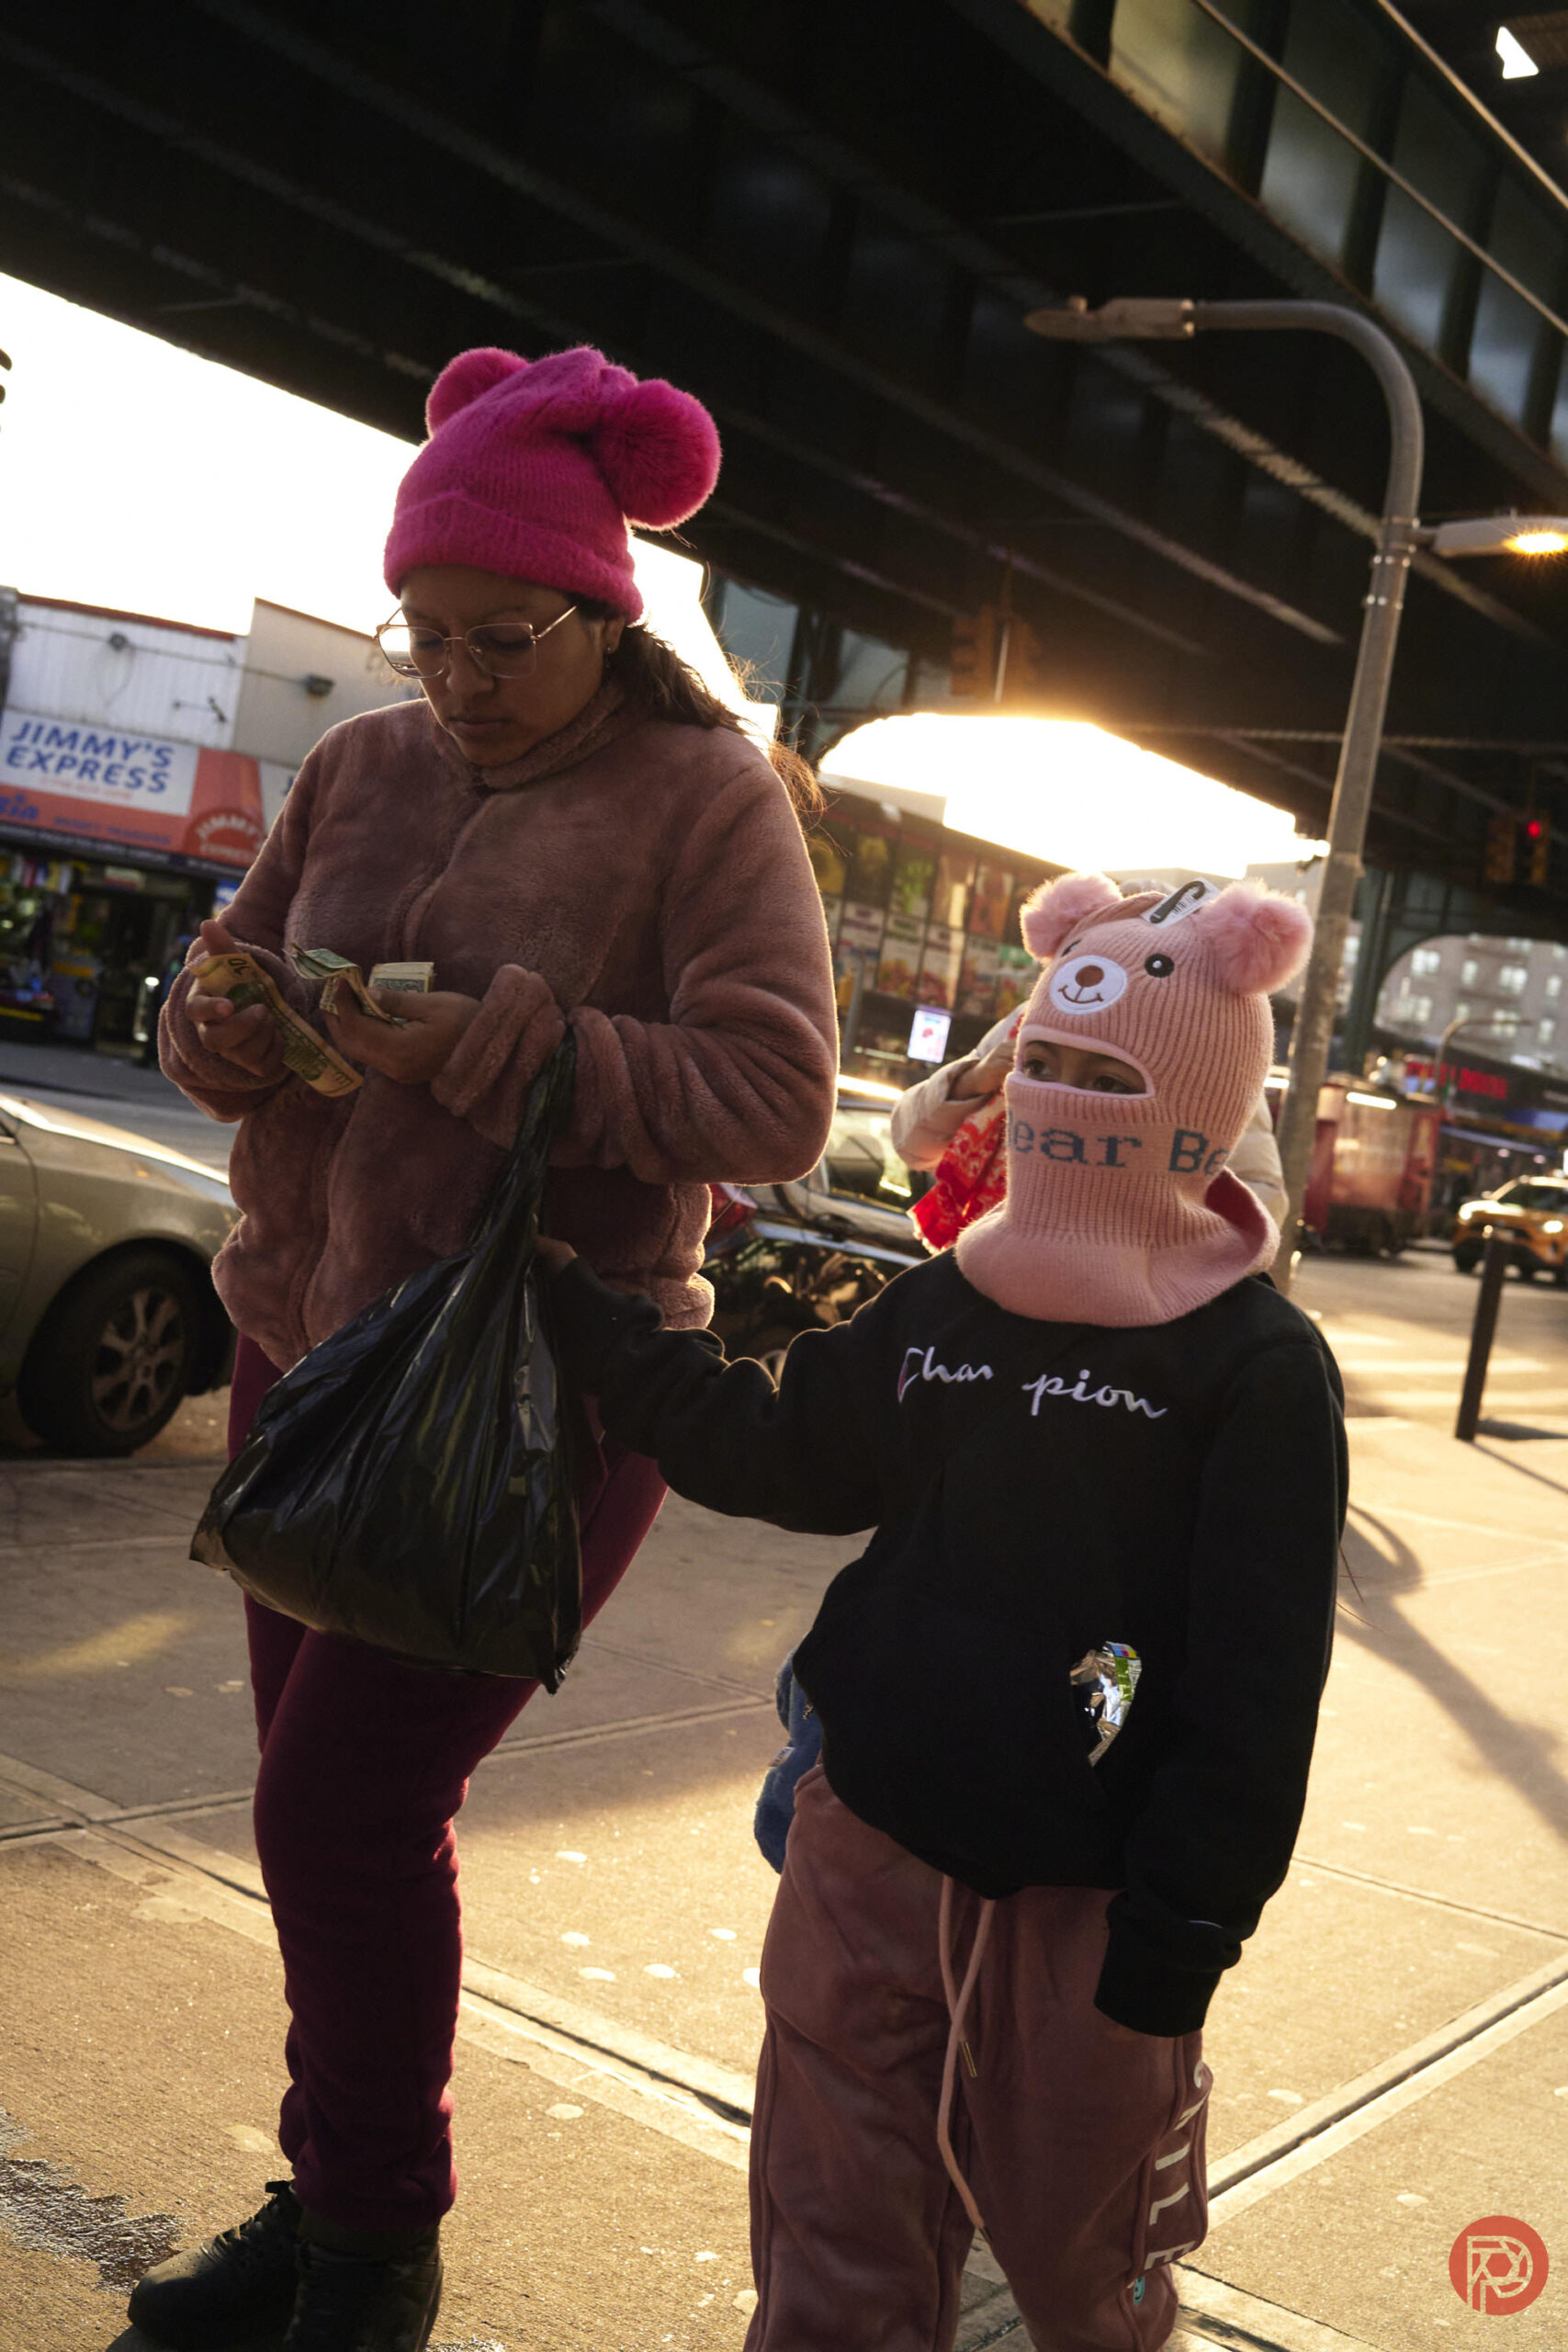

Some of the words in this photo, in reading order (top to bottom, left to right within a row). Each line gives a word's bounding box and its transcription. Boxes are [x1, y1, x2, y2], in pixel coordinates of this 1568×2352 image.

[6, 745, 170, 794] EXPRESS
[11, 721, 175, 769] JIMMY'S
[1007, 1109, 1142, 1168] ear
